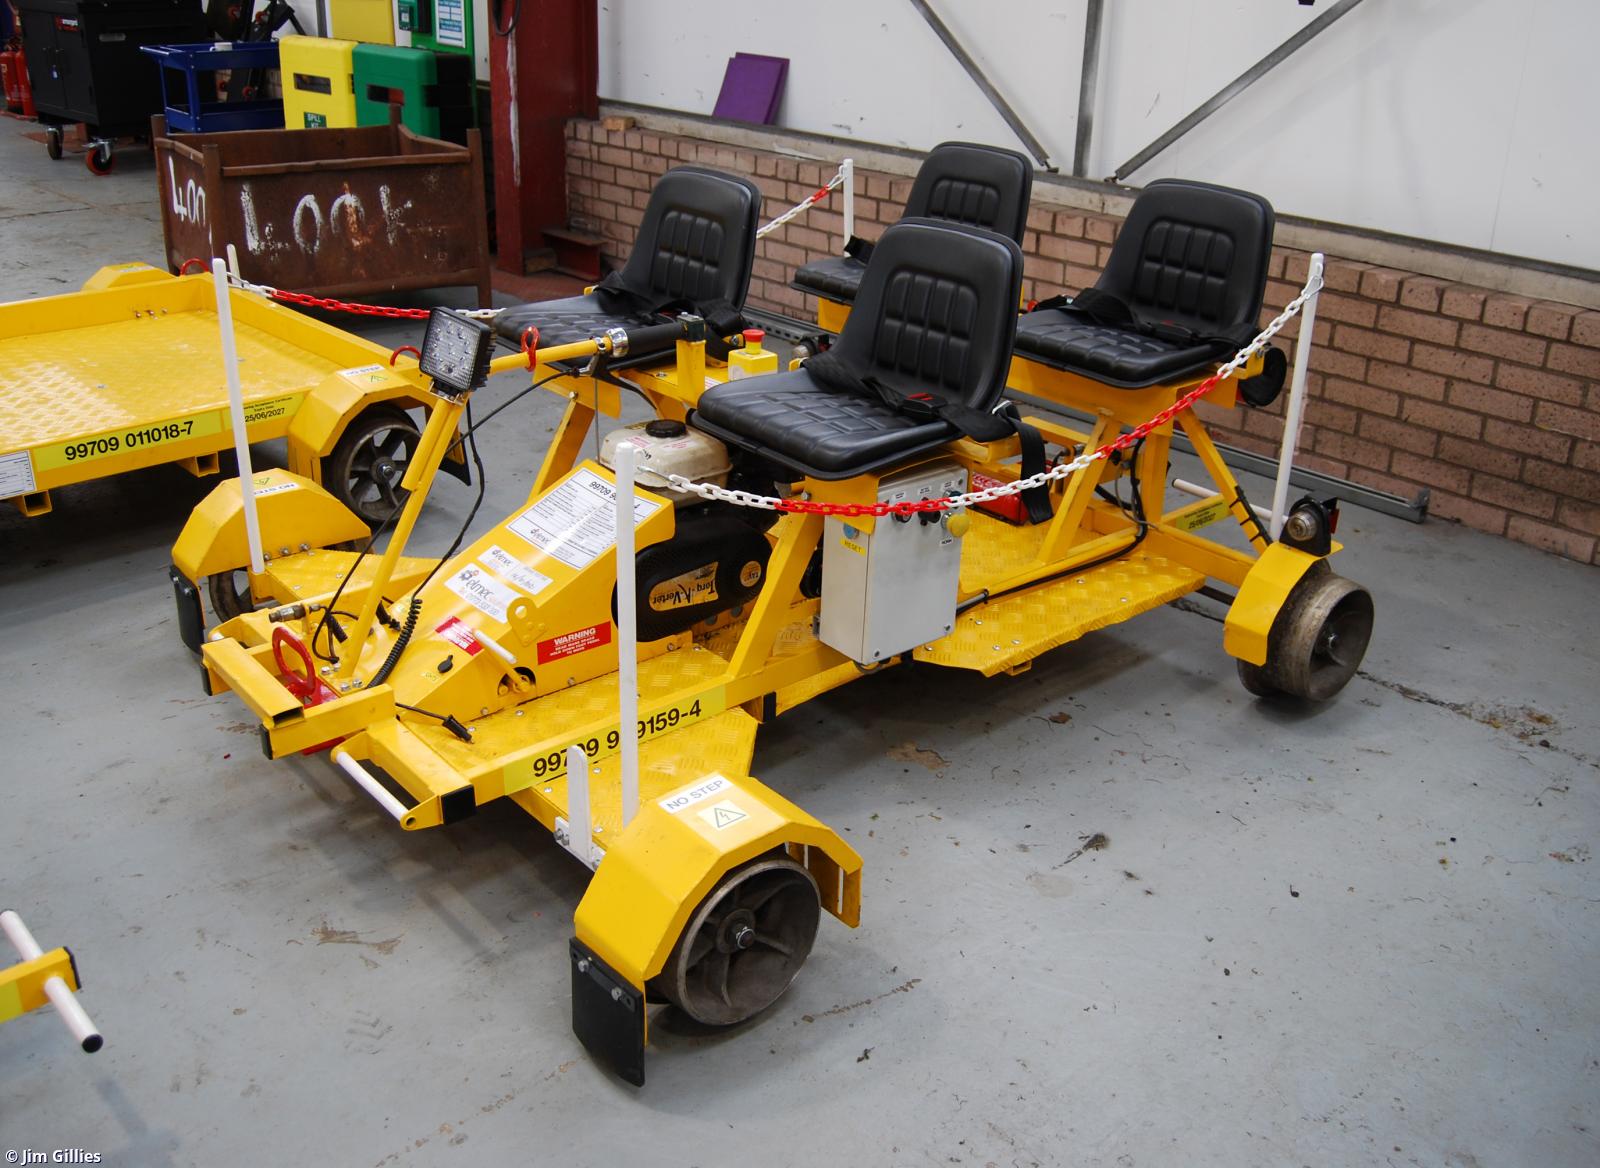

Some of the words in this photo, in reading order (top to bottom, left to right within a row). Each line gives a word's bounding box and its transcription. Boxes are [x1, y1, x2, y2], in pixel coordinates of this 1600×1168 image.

[244, 407, 285, 423] 25/06/2027
[65, 436, 120, 461] 99709
[125, 420, 194, 448] 011018-7
[588, 481, 612, 497] 99709
[554, 628, 596, 645] WARNING
[533, 737, 600, 778] 9979
[607, 700, 701, 749] 99159-4
[666, 796, 689, 810] NO
[689, 779, 723, 799] STEP
